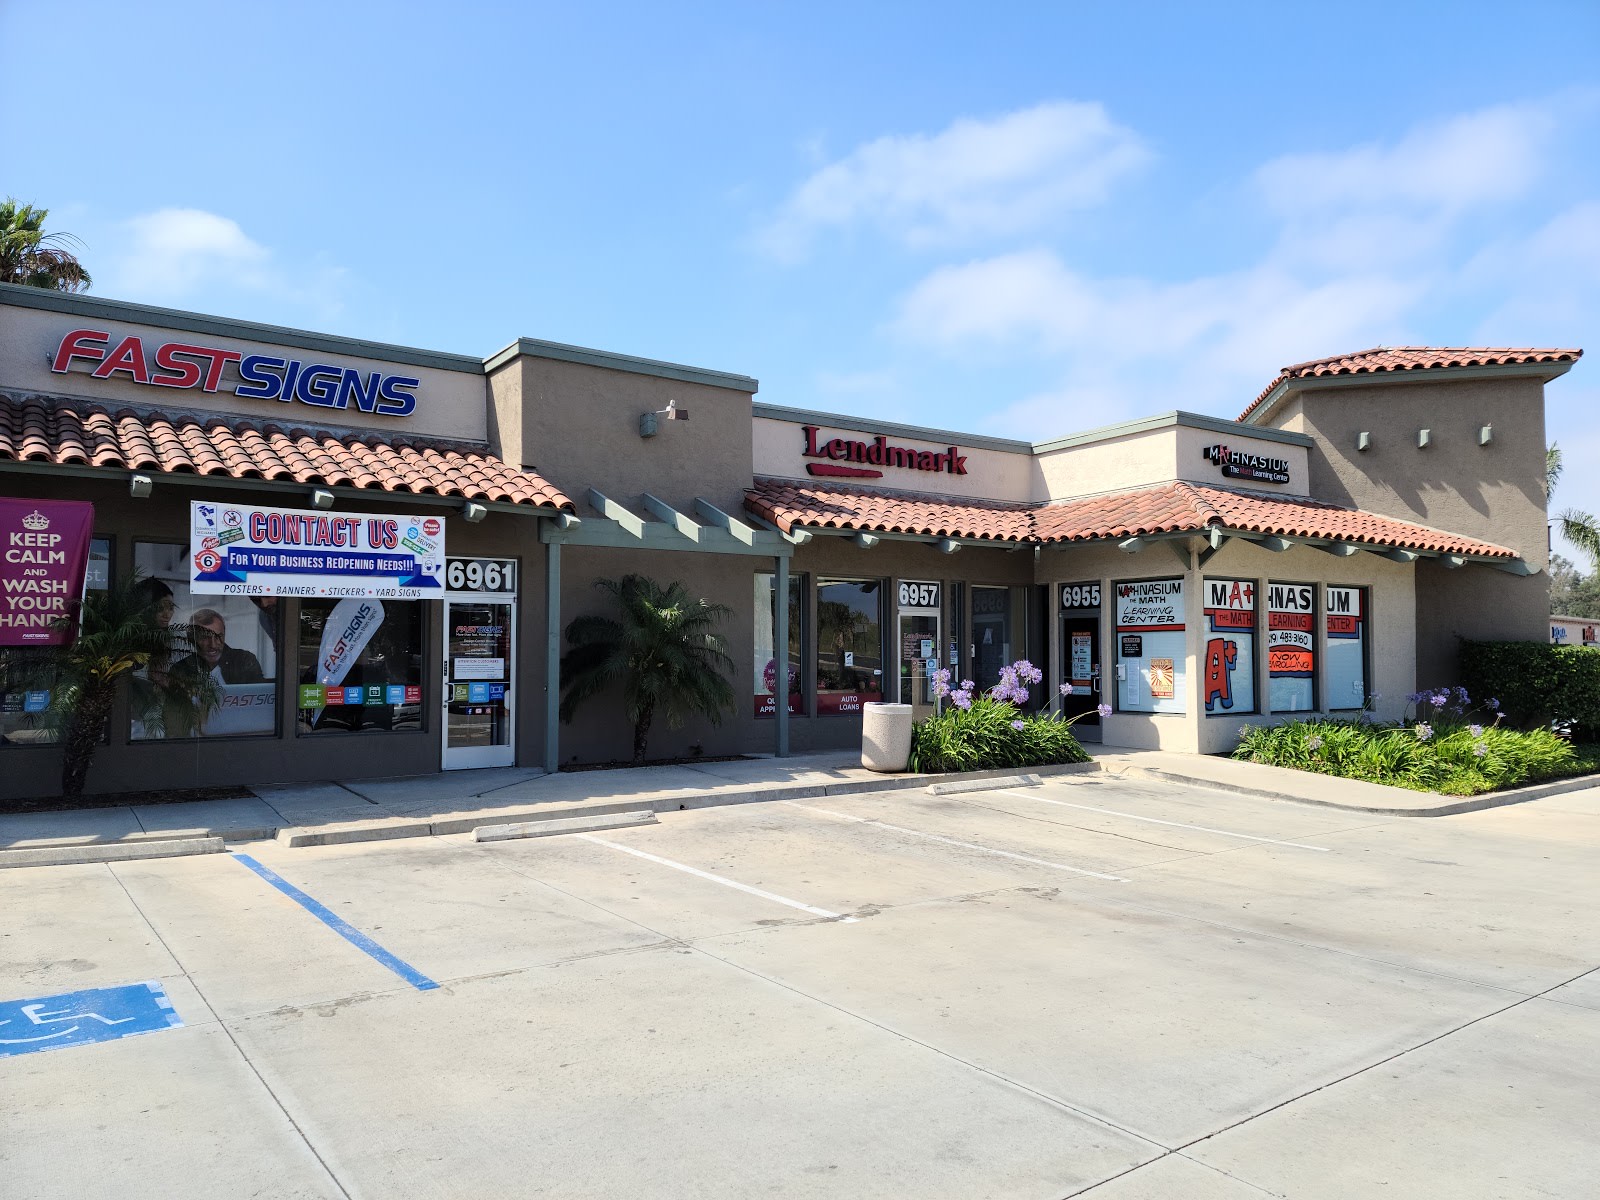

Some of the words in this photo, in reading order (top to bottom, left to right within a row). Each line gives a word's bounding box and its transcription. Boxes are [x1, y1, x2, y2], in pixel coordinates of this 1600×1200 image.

[51, 329, 420, 417] FASTSIGNS
[802, 426, 968, 475] Lendmark
[1230, 466, 1240, 474] The
[1240, 467, 1252, 475] Math
[1252, 469, 1273, 482] Learning
[1273, 472, 1288, 481] Center
[250, 512, 361, 547] CONTACT
[368, 519, 399, 549] US
[10, 532, 62, 547] KEEP
[5, 550, 65, 565] CALM
[204, 556, 213, 567] 6
[280, 555, 324, 569] BUSINESS
[24, 569, 48, 577] AND
[448, 561, 513, 590] 6961
[2, 579, 68, 593] WASH
[224, 584, 263, 594] POSTERS
[276, 586, 316, 596] BANNERS
[328, 587, 366, 597] STICKERS
[375, 588, 397, 597] YARD
[398, 588, 422, 597] SIGNS
[899, 584, 938, 606] 6957
[1063, 586, 1100, 607] 6955
[1139, 596, 1166, 604] MATH
[6, 596, 65, 611] YOUR
[1123, 605, 1173, 615] LEARNING
[1122, 615, 1175, 624] CENTER
[1230, 611, 1252, 625] MATH
[323, 602, 373, 672] FASTSIGNS
[1272, 653, 1301, 661] NOW
